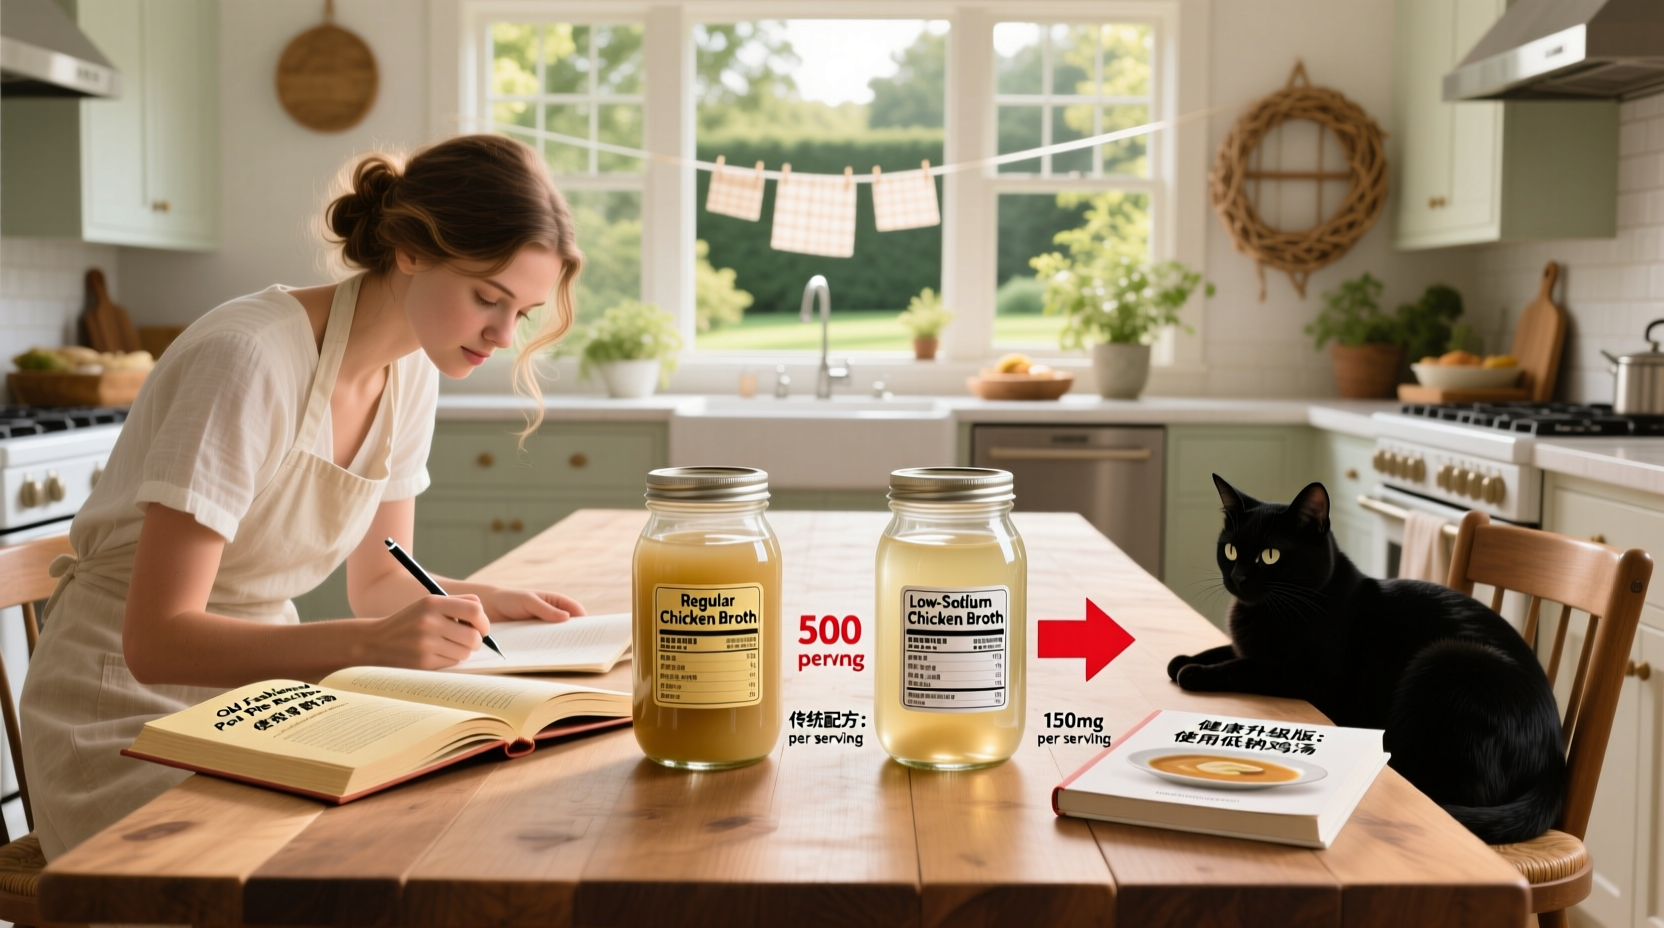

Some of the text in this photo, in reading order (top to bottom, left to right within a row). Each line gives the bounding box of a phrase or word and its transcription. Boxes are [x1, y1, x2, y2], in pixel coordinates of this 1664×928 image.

[681, 593, 735, 612] Regular
[660, 610, 757, 625] Chicken Broth
[908, 610, 1004, 626] Chicken Broth
